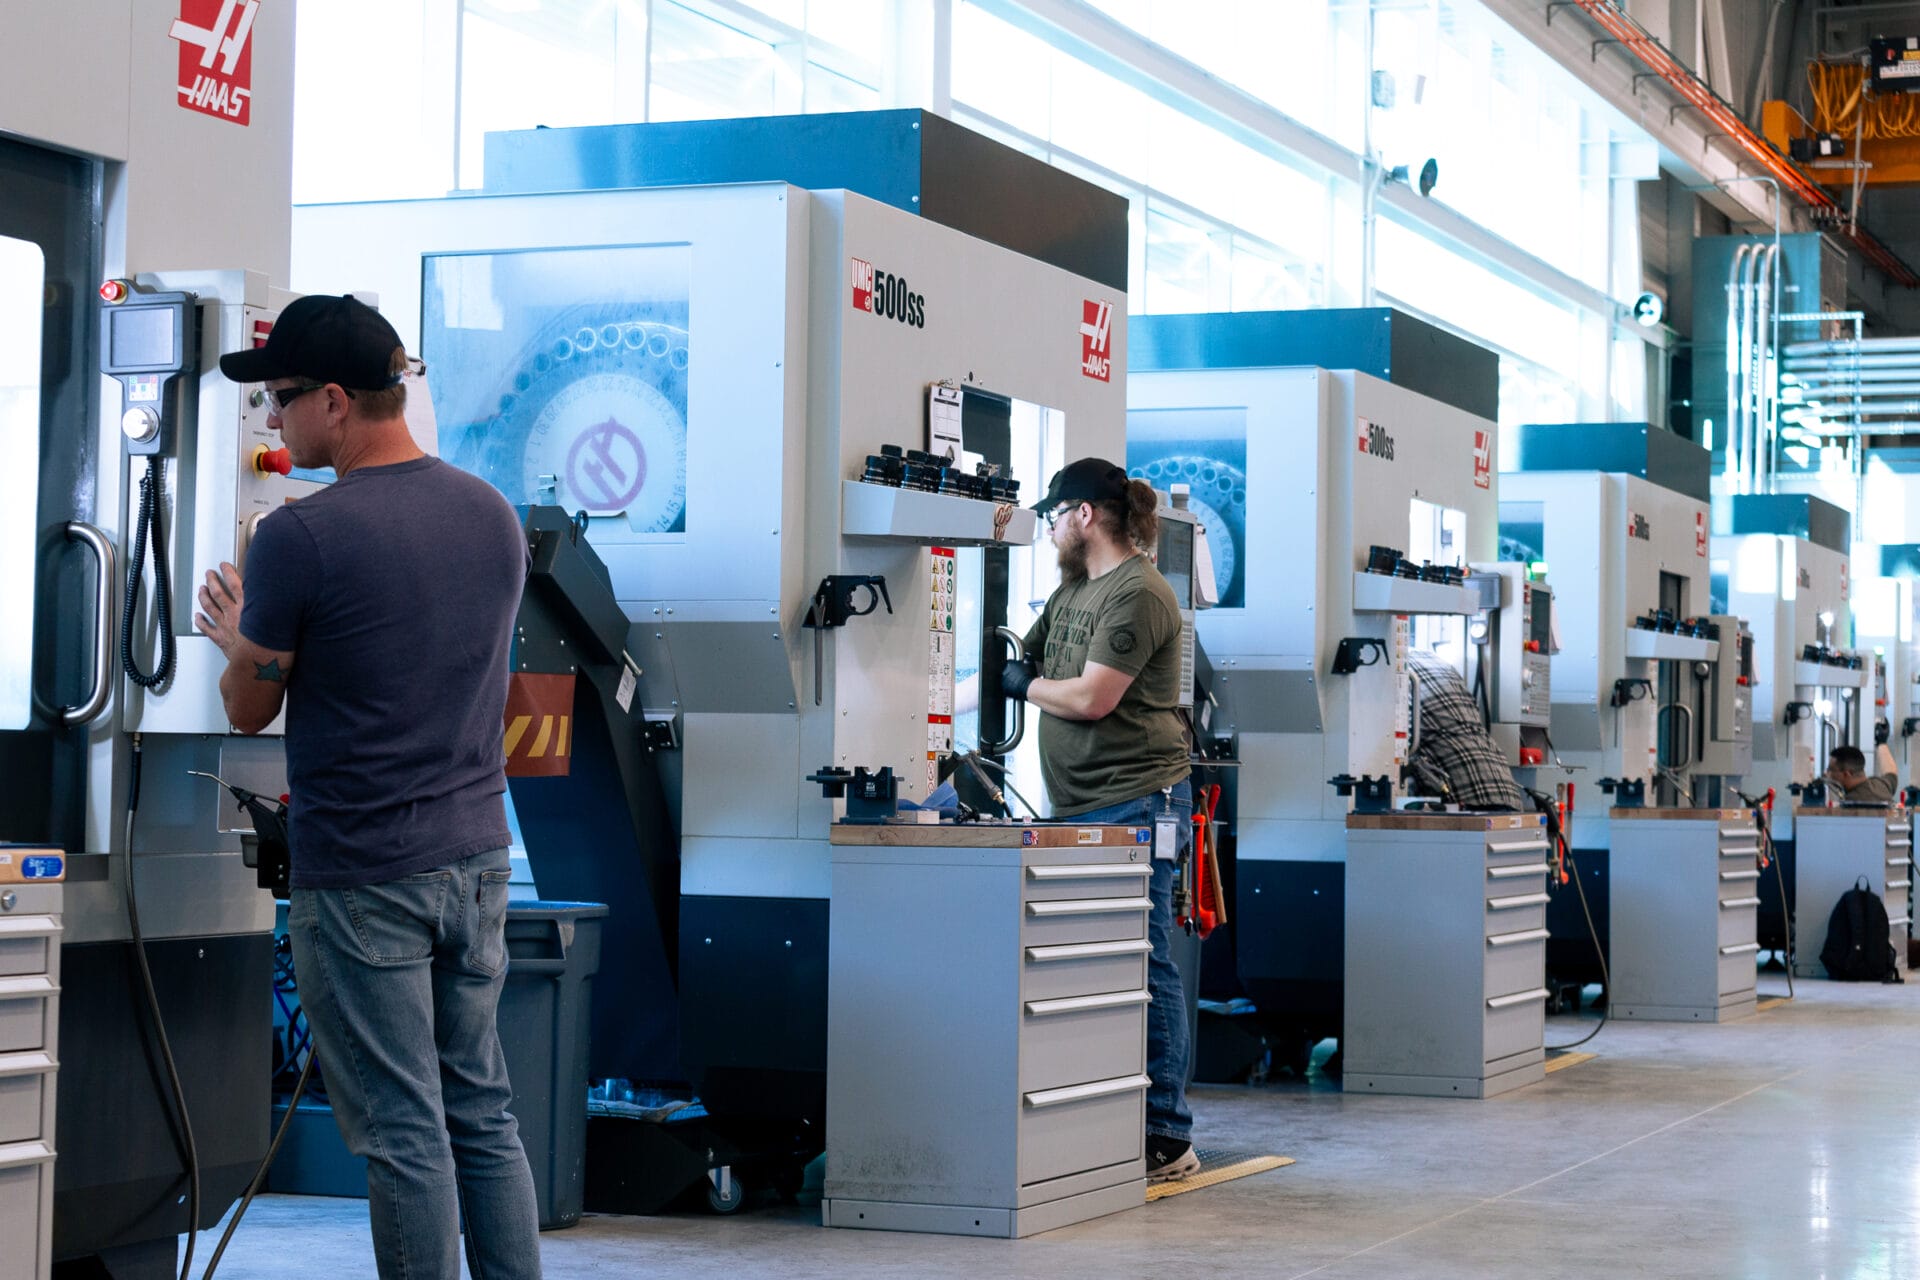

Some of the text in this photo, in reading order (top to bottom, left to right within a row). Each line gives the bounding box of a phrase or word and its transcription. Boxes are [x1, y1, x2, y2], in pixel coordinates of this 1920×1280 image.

[178, 74, 250, 117] HAAS
[852, 257, 872, 293] UMC
[1082, 353, 1111, 378] HAAS
